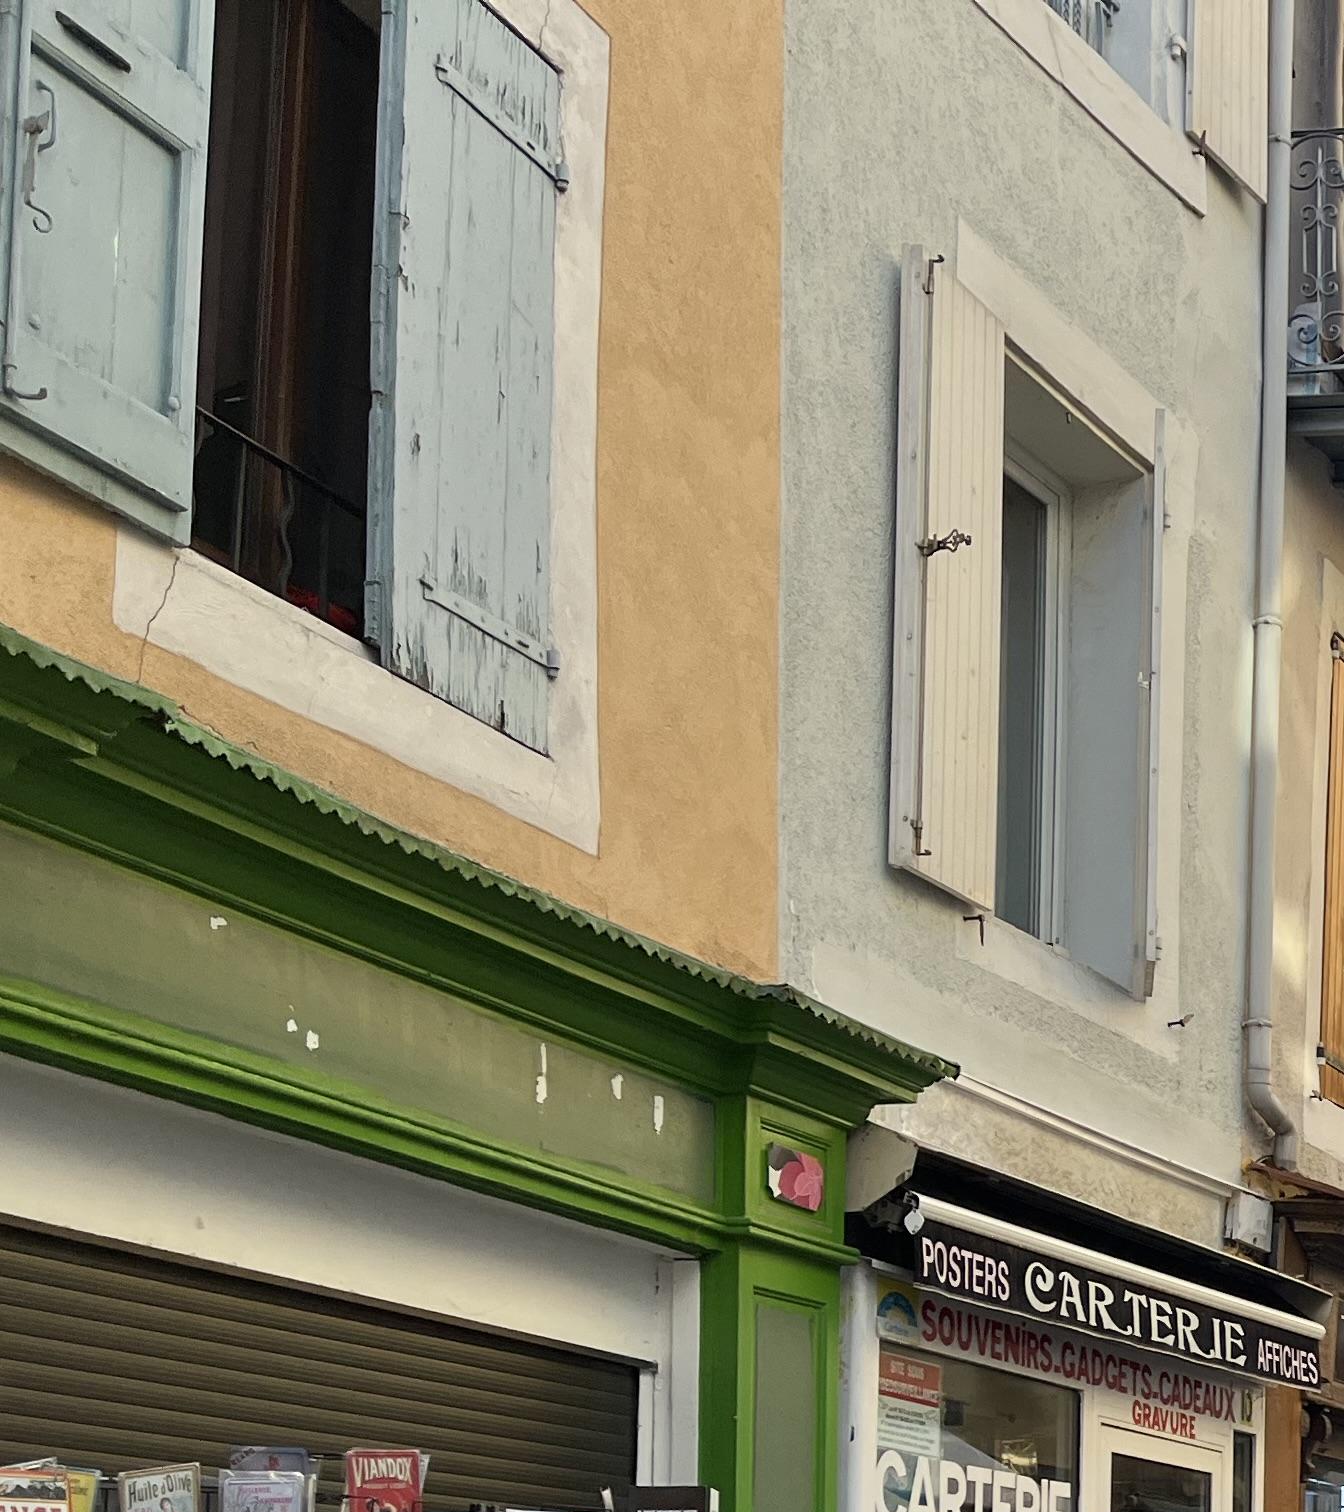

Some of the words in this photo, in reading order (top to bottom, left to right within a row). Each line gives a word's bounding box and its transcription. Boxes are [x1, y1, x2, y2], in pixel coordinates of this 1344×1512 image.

[921, 1236, 1011, 1301] POSTERS
[1023, 1260, 1249, 1367] CARTERIE
[1257, 1337, 1319, 1386] AFFICHES
[1131, 1398, 1197, 1441] GRAVURE
[351, 1456, 414, 1489] VIANDOX
[128, 1479, 160, 1511] Huile
